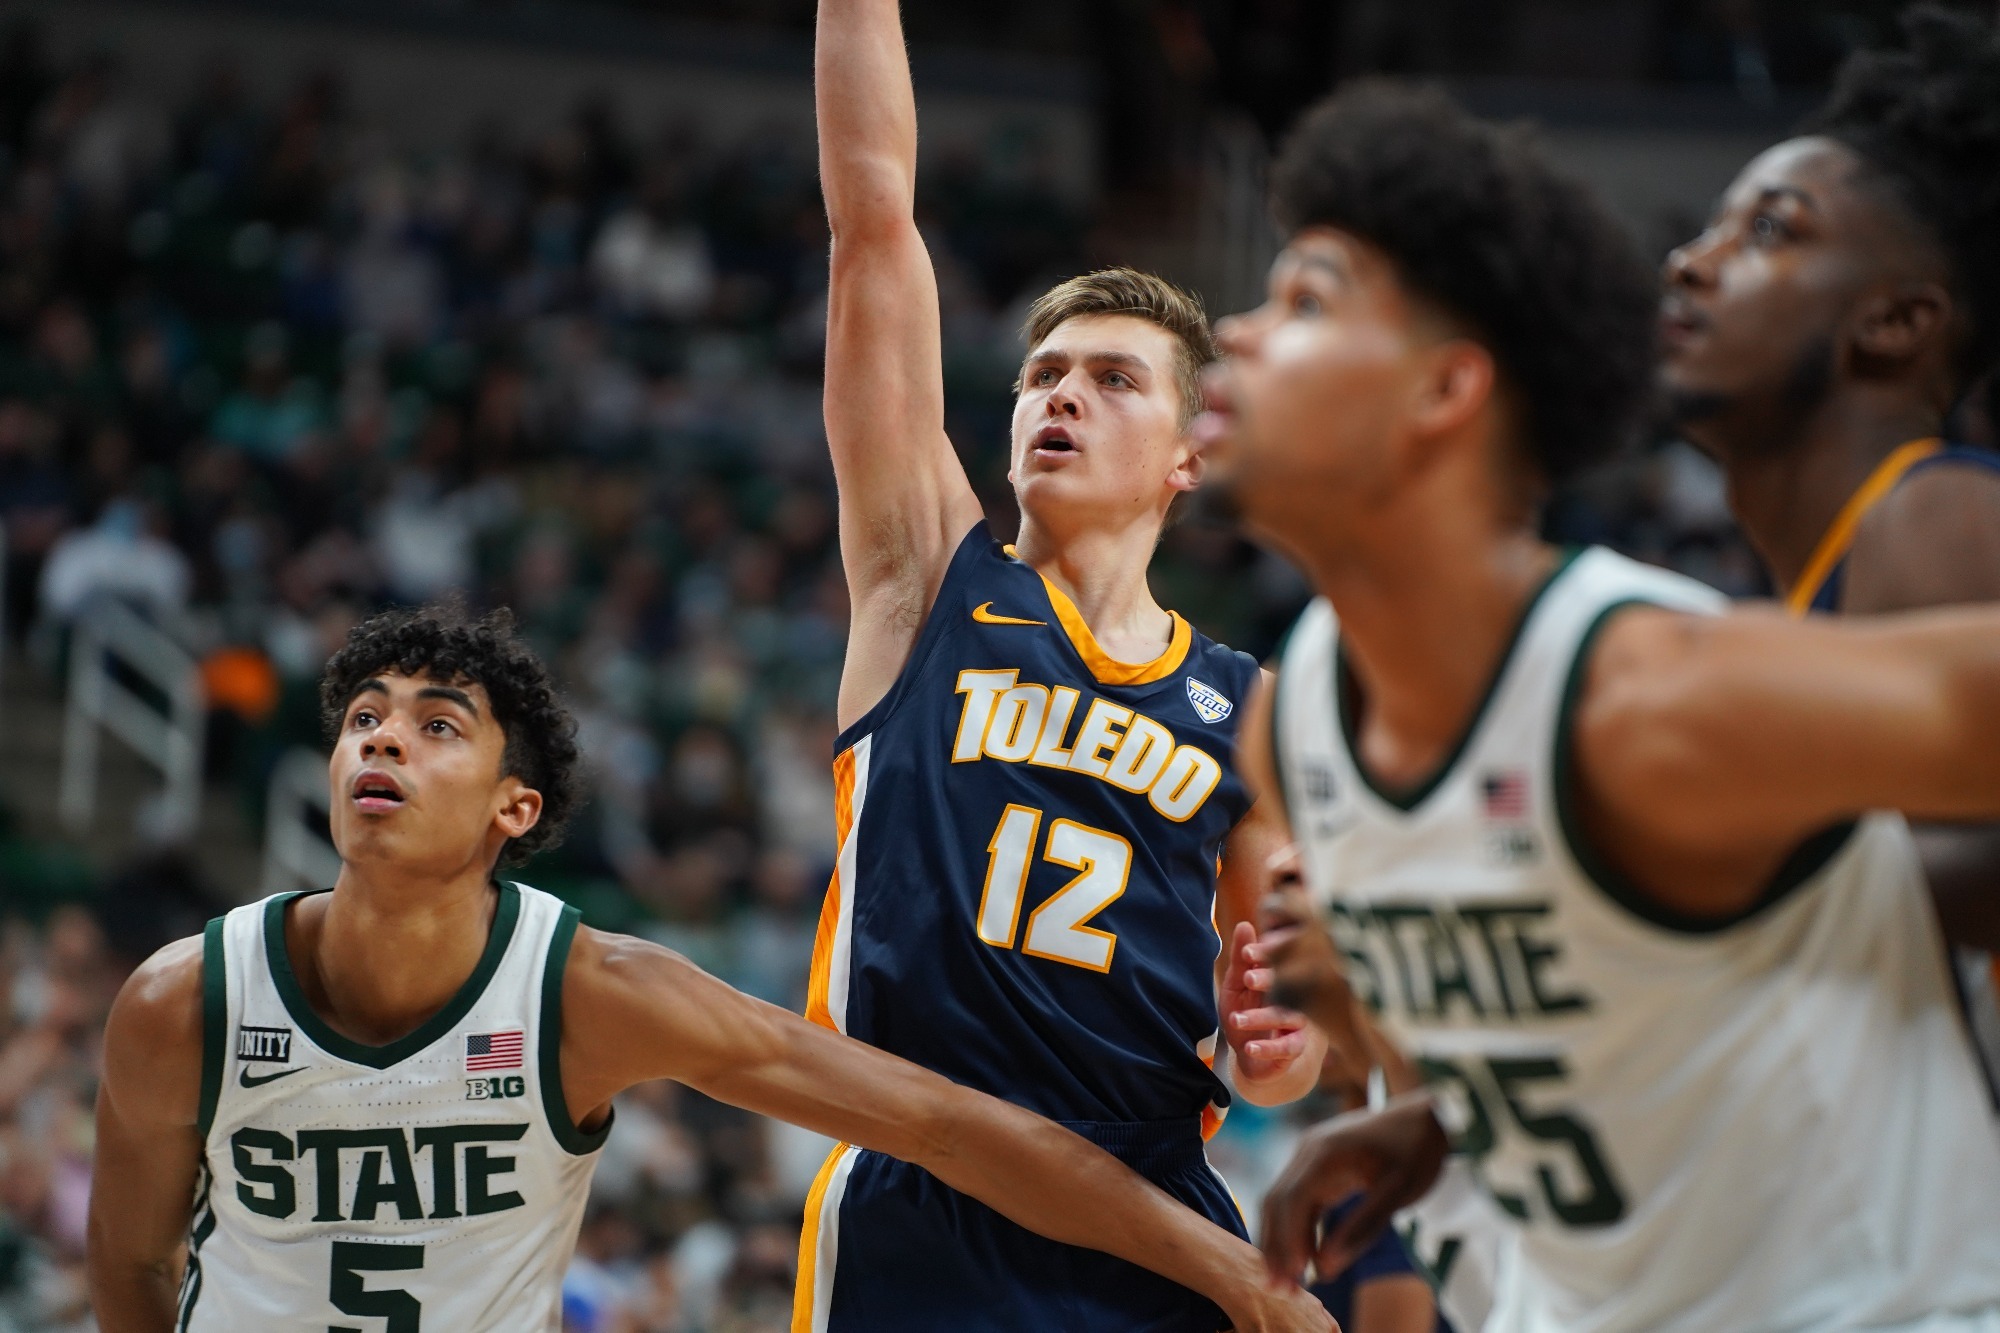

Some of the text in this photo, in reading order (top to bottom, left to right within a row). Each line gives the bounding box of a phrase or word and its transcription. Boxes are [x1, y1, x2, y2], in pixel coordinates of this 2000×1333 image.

[951, 668, 1222, 823] TOLEDO
[976, 803, 1133, 974] 12
[1331, 899, 1591, 1020] STATE
[231, 1122, 530, 1222] STATE
[328, 1241, 425, 1333] 5
